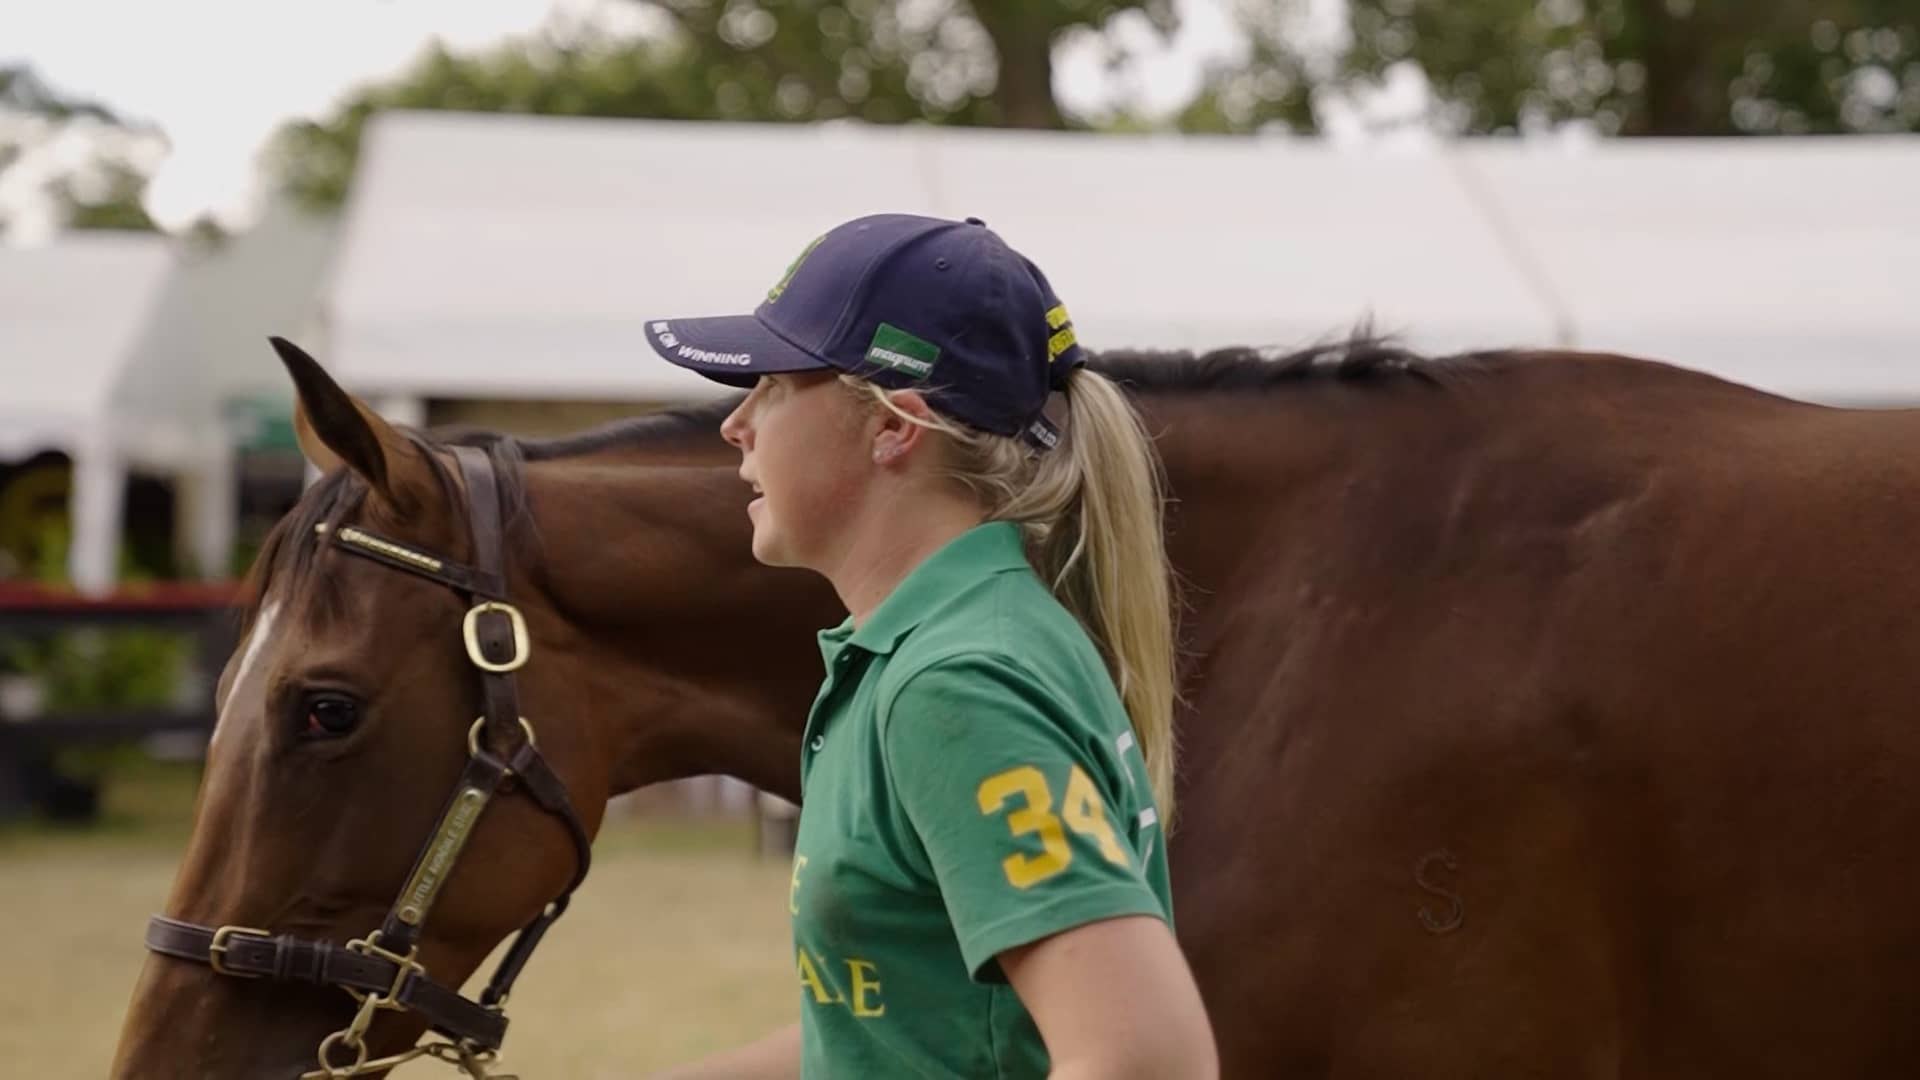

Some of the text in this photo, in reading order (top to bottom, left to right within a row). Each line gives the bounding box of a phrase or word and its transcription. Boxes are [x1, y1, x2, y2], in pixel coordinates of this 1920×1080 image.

[678, 345, 751, 366] WINNING
[977, 764, 1129, 890] 34
[1416, 850, 1464, 933] S
